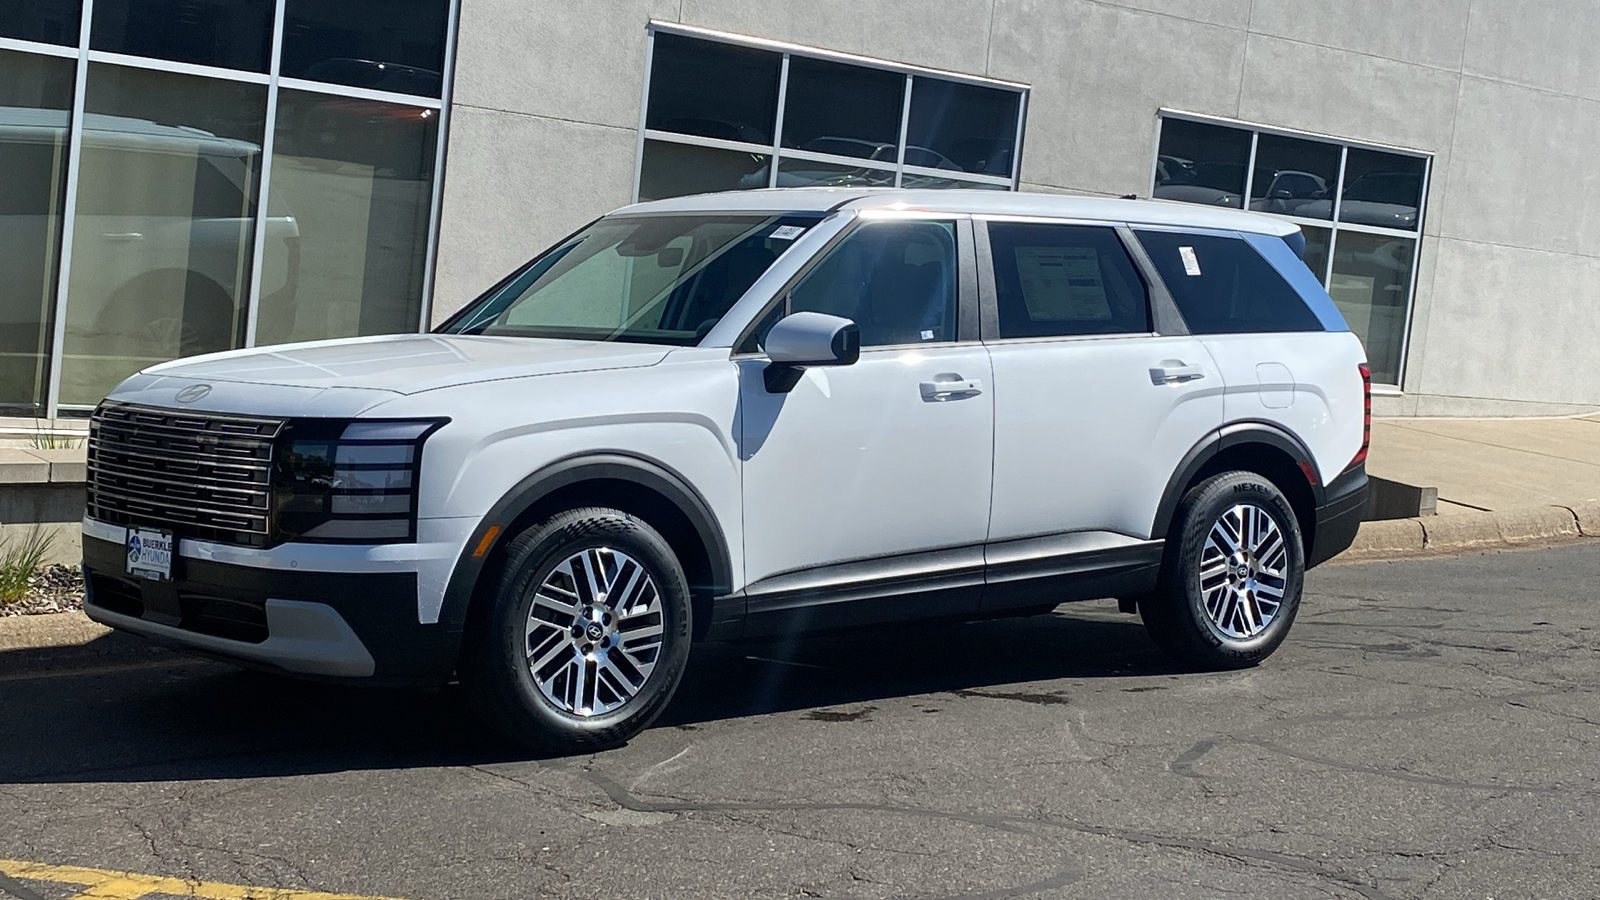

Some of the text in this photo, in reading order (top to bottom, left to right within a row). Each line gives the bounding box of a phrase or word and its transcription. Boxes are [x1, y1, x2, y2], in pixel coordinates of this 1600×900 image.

[1233, 482, 1271, 495] NEXEN
[142, 538, 172, 552] BUERKLE
[141, 548, 171, 565] HYUNDA
